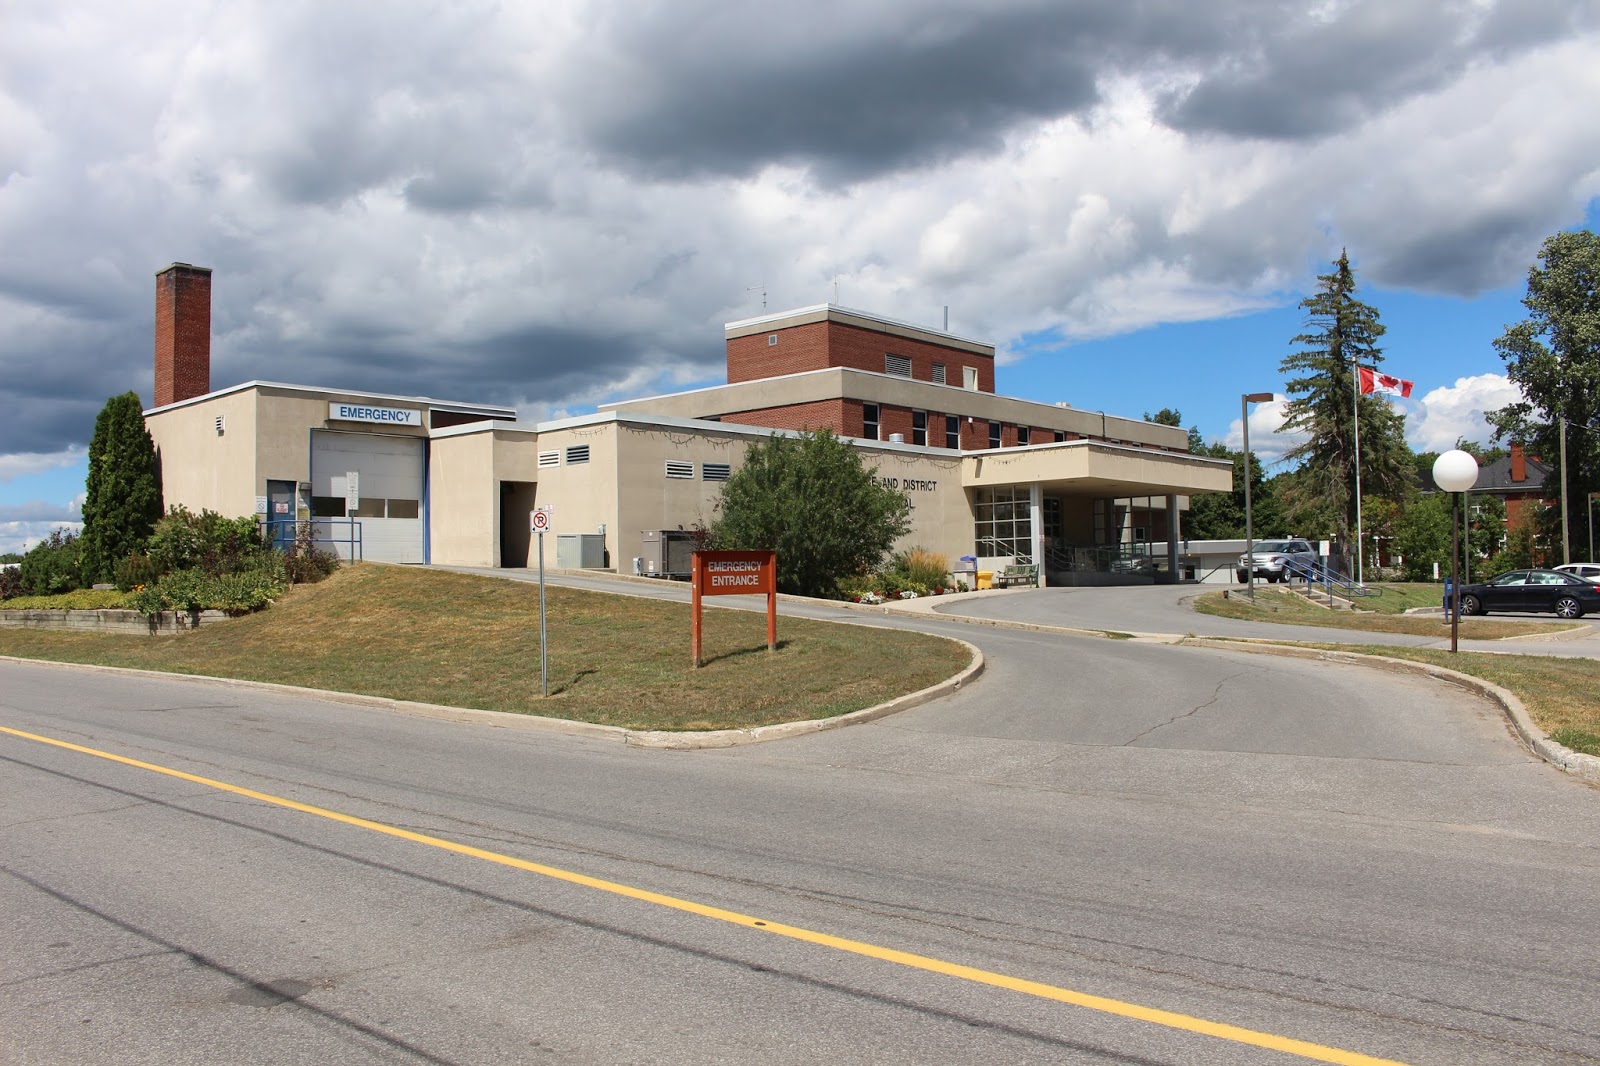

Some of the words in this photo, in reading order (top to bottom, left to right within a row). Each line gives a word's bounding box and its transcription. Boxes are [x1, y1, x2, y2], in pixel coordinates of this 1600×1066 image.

[340, 406, 411, 422] EMERGENCY
[882, 477, 899, 489] AND
[903, 479, 937, 491] DISTRICT
[708, 561, 762, 572] EMERGENCY
[712, 575, 759, 586] ENTRANCE
